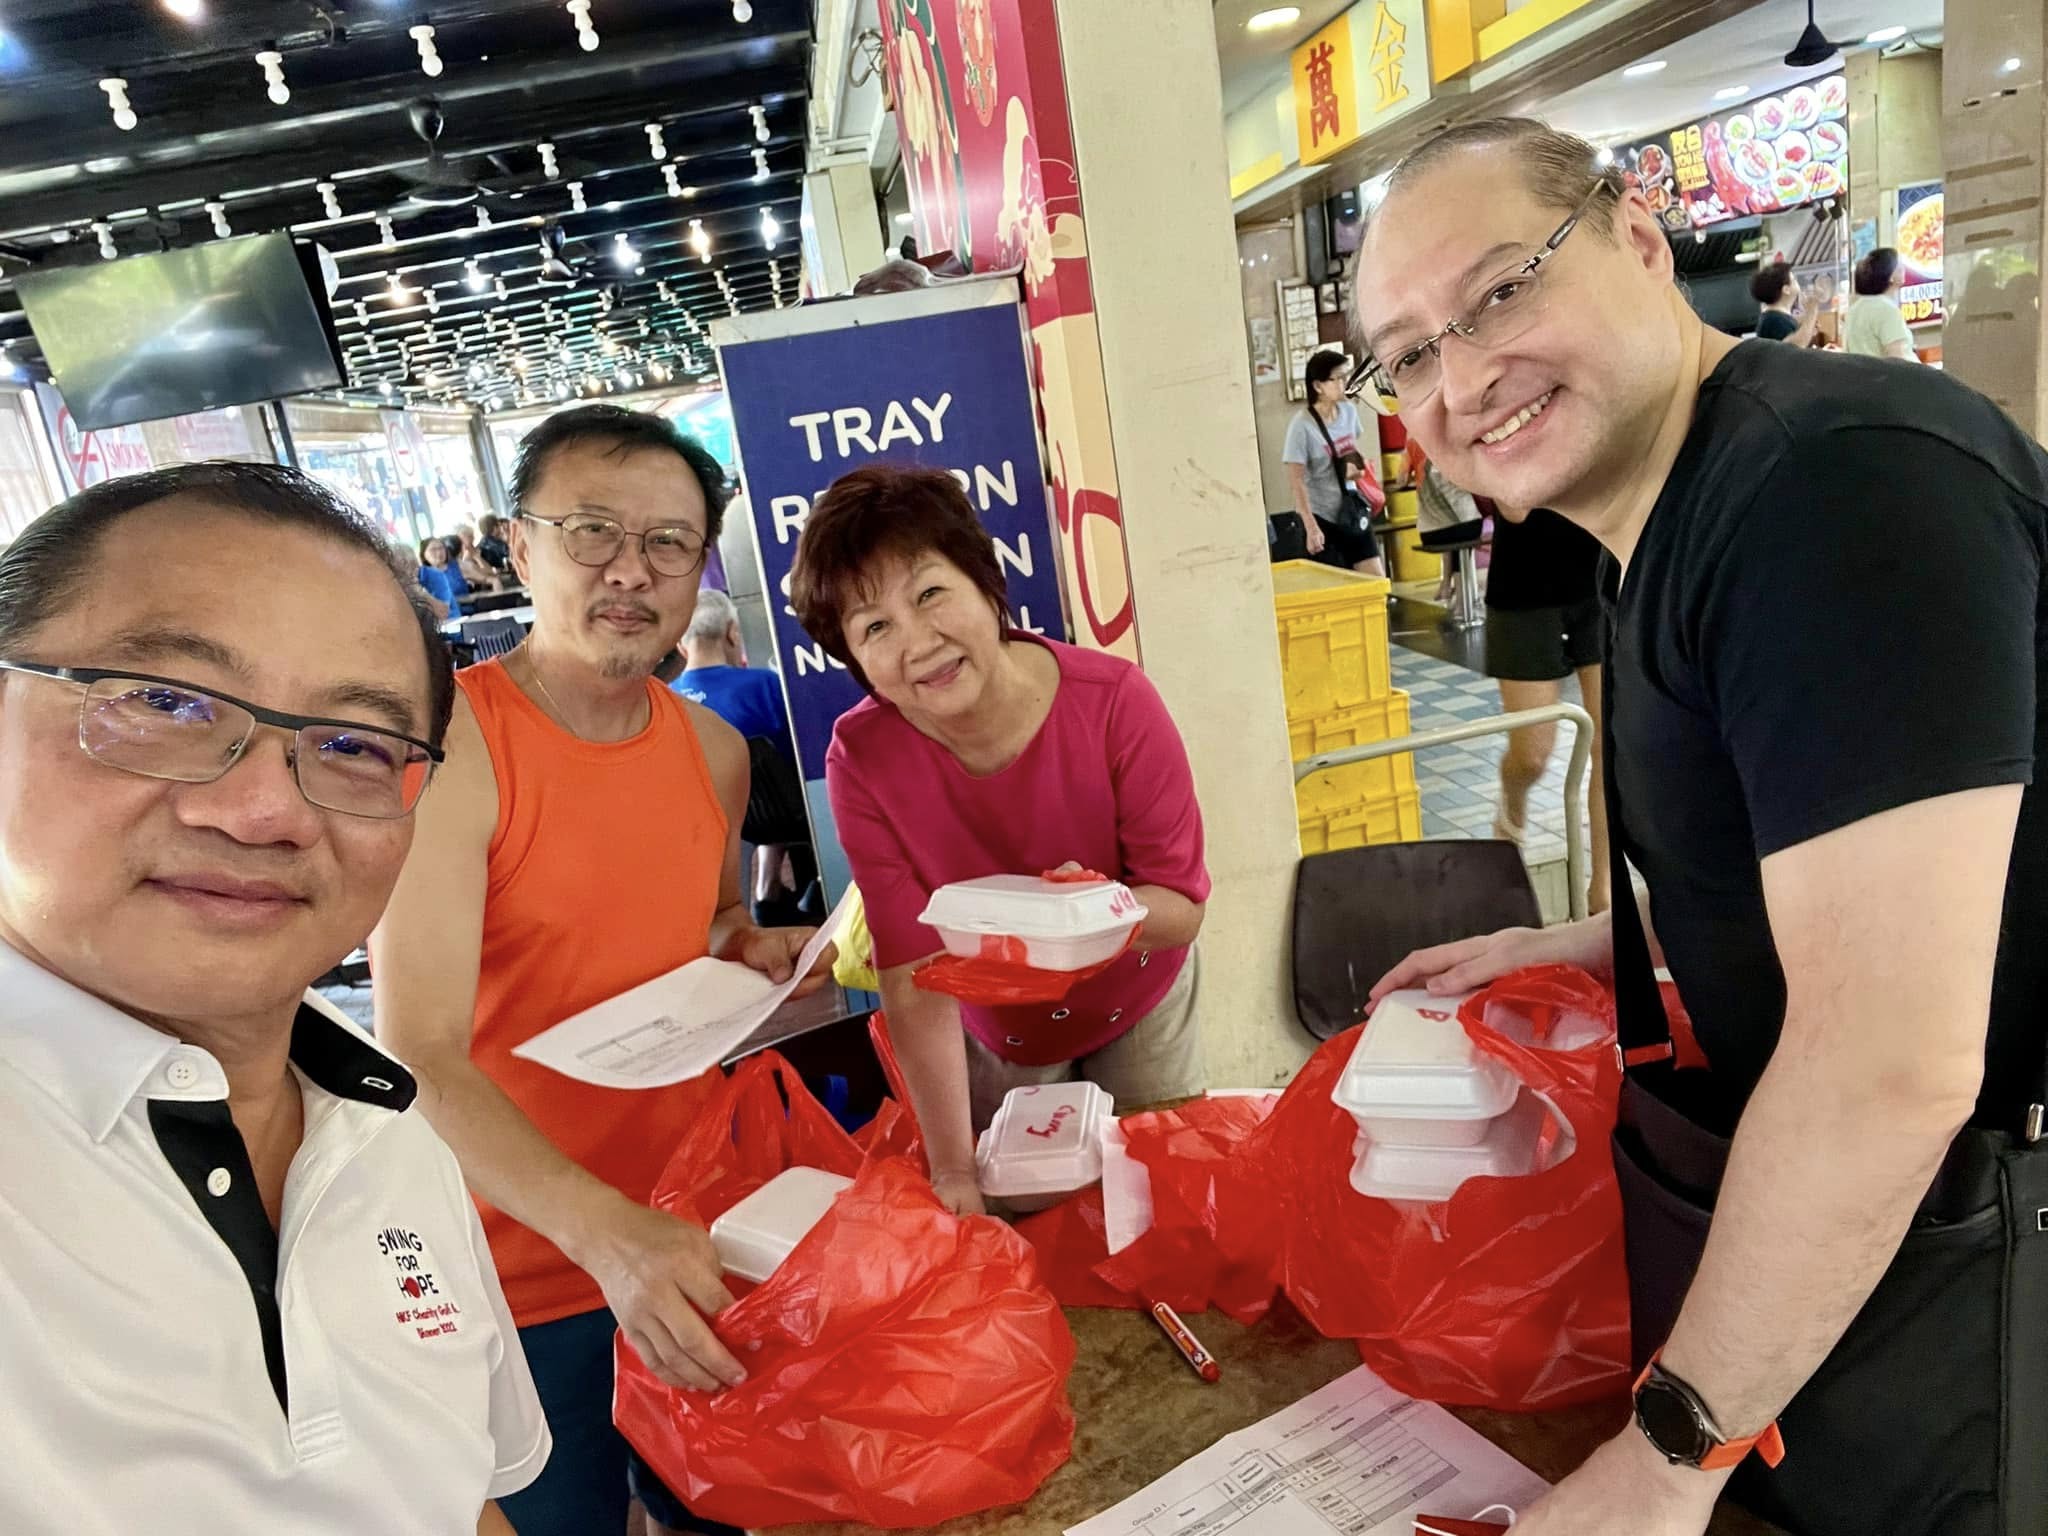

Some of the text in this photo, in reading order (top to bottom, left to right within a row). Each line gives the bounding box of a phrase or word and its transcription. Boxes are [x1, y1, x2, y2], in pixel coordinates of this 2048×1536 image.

[789, 393, 952, 462] TRAY
[377, 1227, 423, 1255] SWING
[395, 1254, 420, 1272] FOR
[396, 1273, 440, 1299] HOPE
